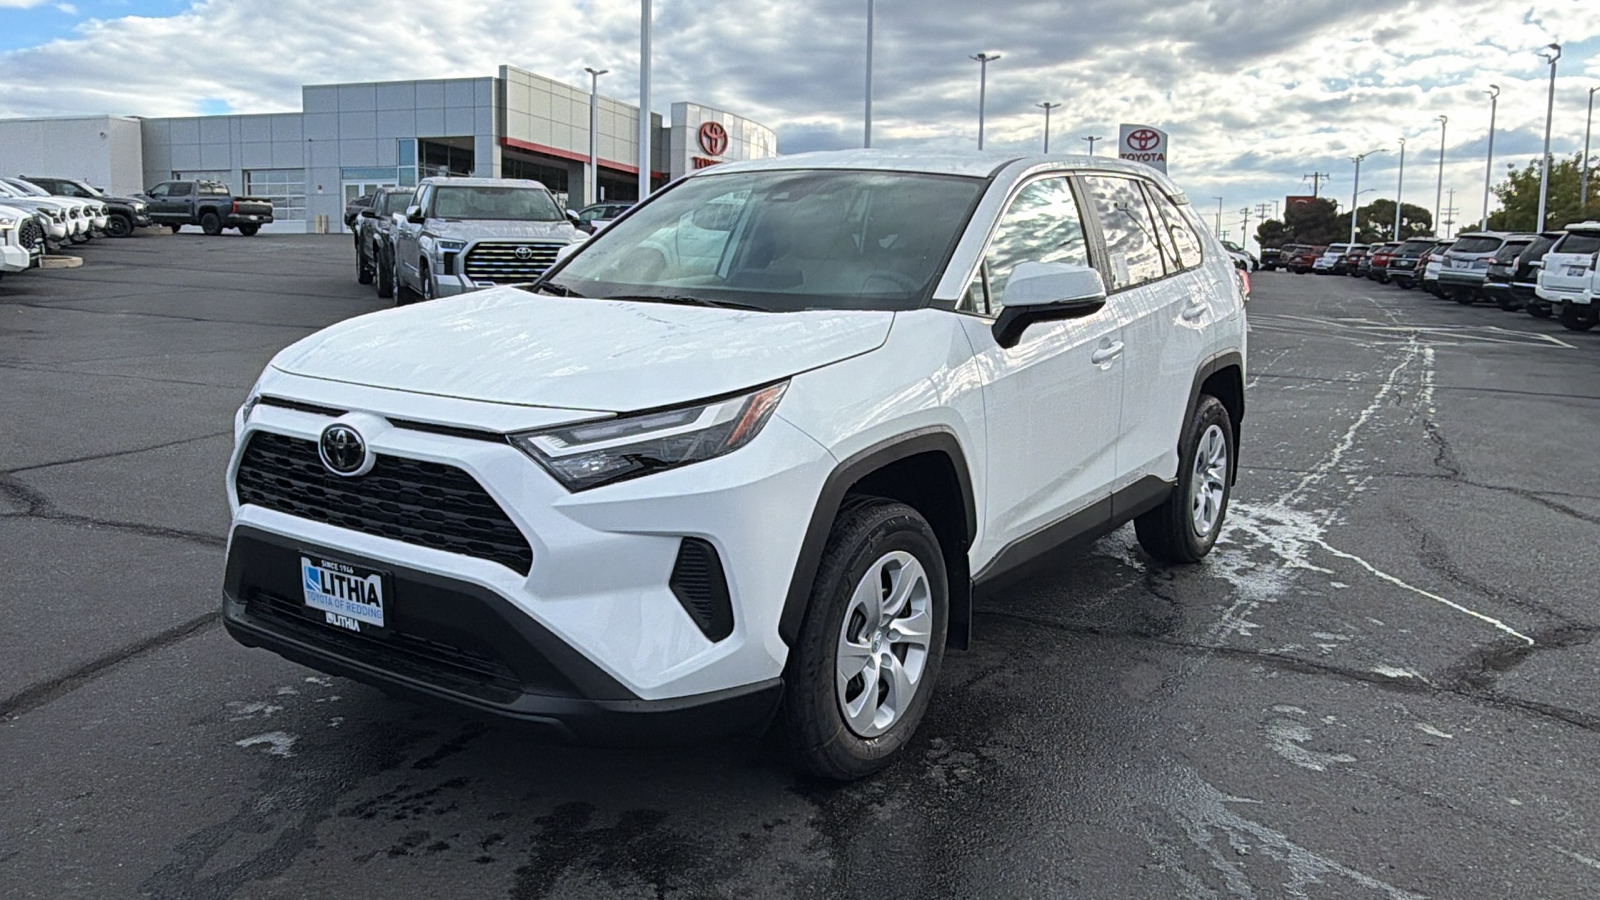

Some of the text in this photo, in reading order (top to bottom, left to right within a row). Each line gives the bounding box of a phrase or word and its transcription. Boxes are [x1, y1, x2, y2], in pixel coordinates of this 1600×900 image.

[1121, 153, 1164, 161] TOYOTA
[321, 560, 354, 574] SINCE 1946
[320, 570, 381, 608] LITHIA
[307, 591, 382, 619] TOYOTA OF REDDING
[333, 613, 361, 632] LITHIA
